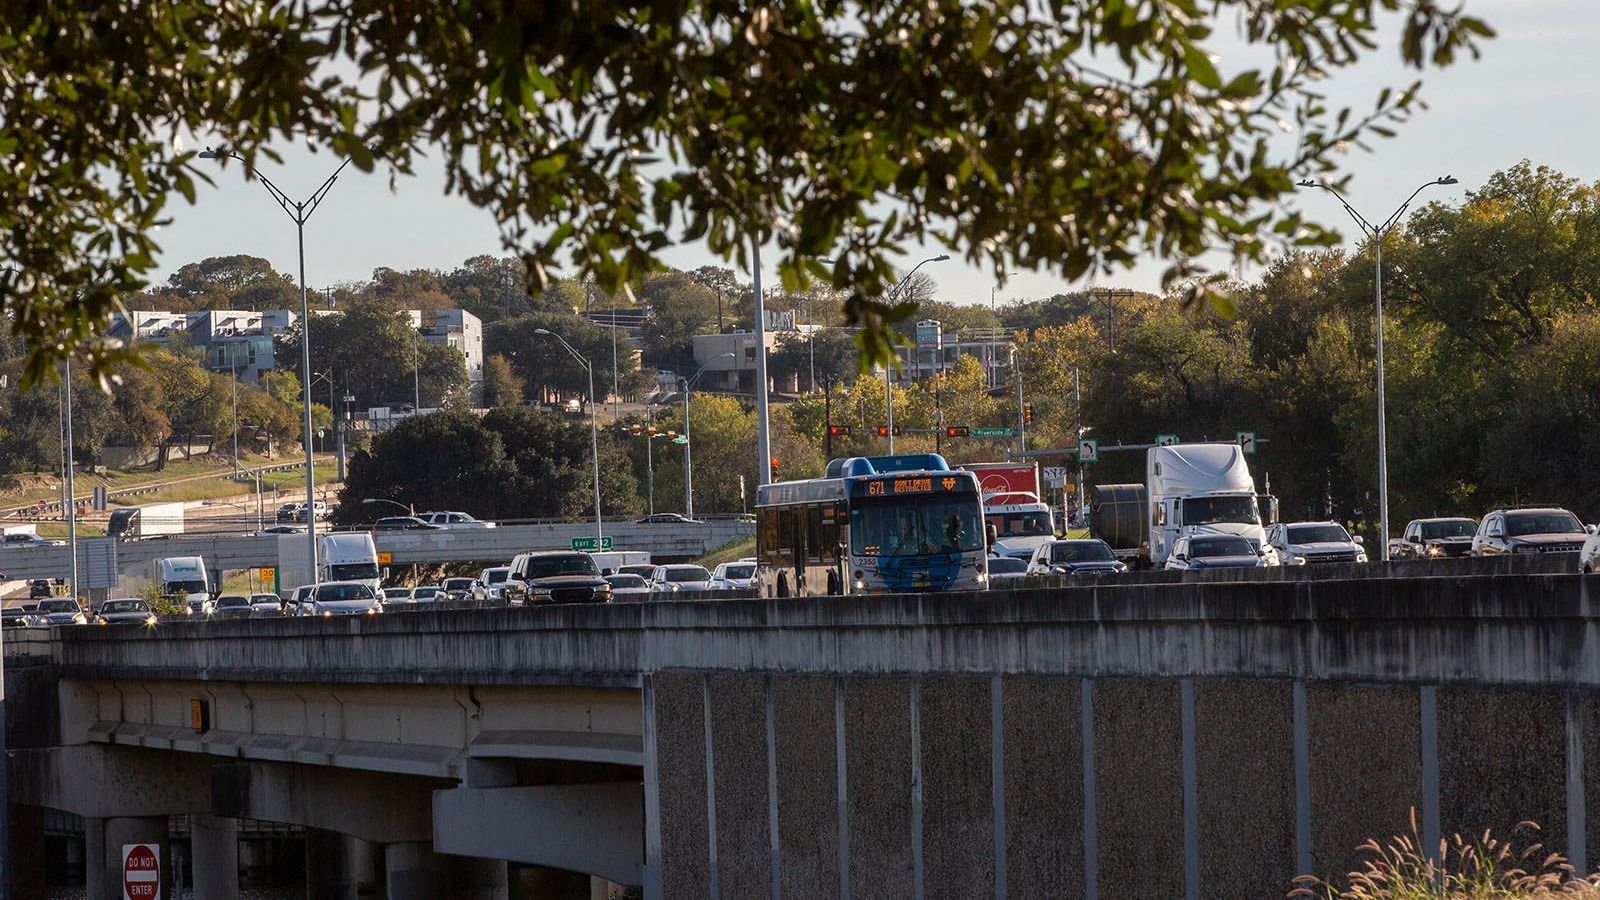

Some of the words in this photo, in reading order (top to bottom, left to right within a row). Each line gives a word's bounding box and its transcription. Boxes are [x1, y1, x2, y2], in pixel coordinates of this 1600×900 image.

[869, 482, 884, 494] 671
[592, 539, 608, 548] 22
[128, 858, 138, 867] DO
[140, 858, 154, 867] NOT
[132, 886, 152, 895] ENTER
